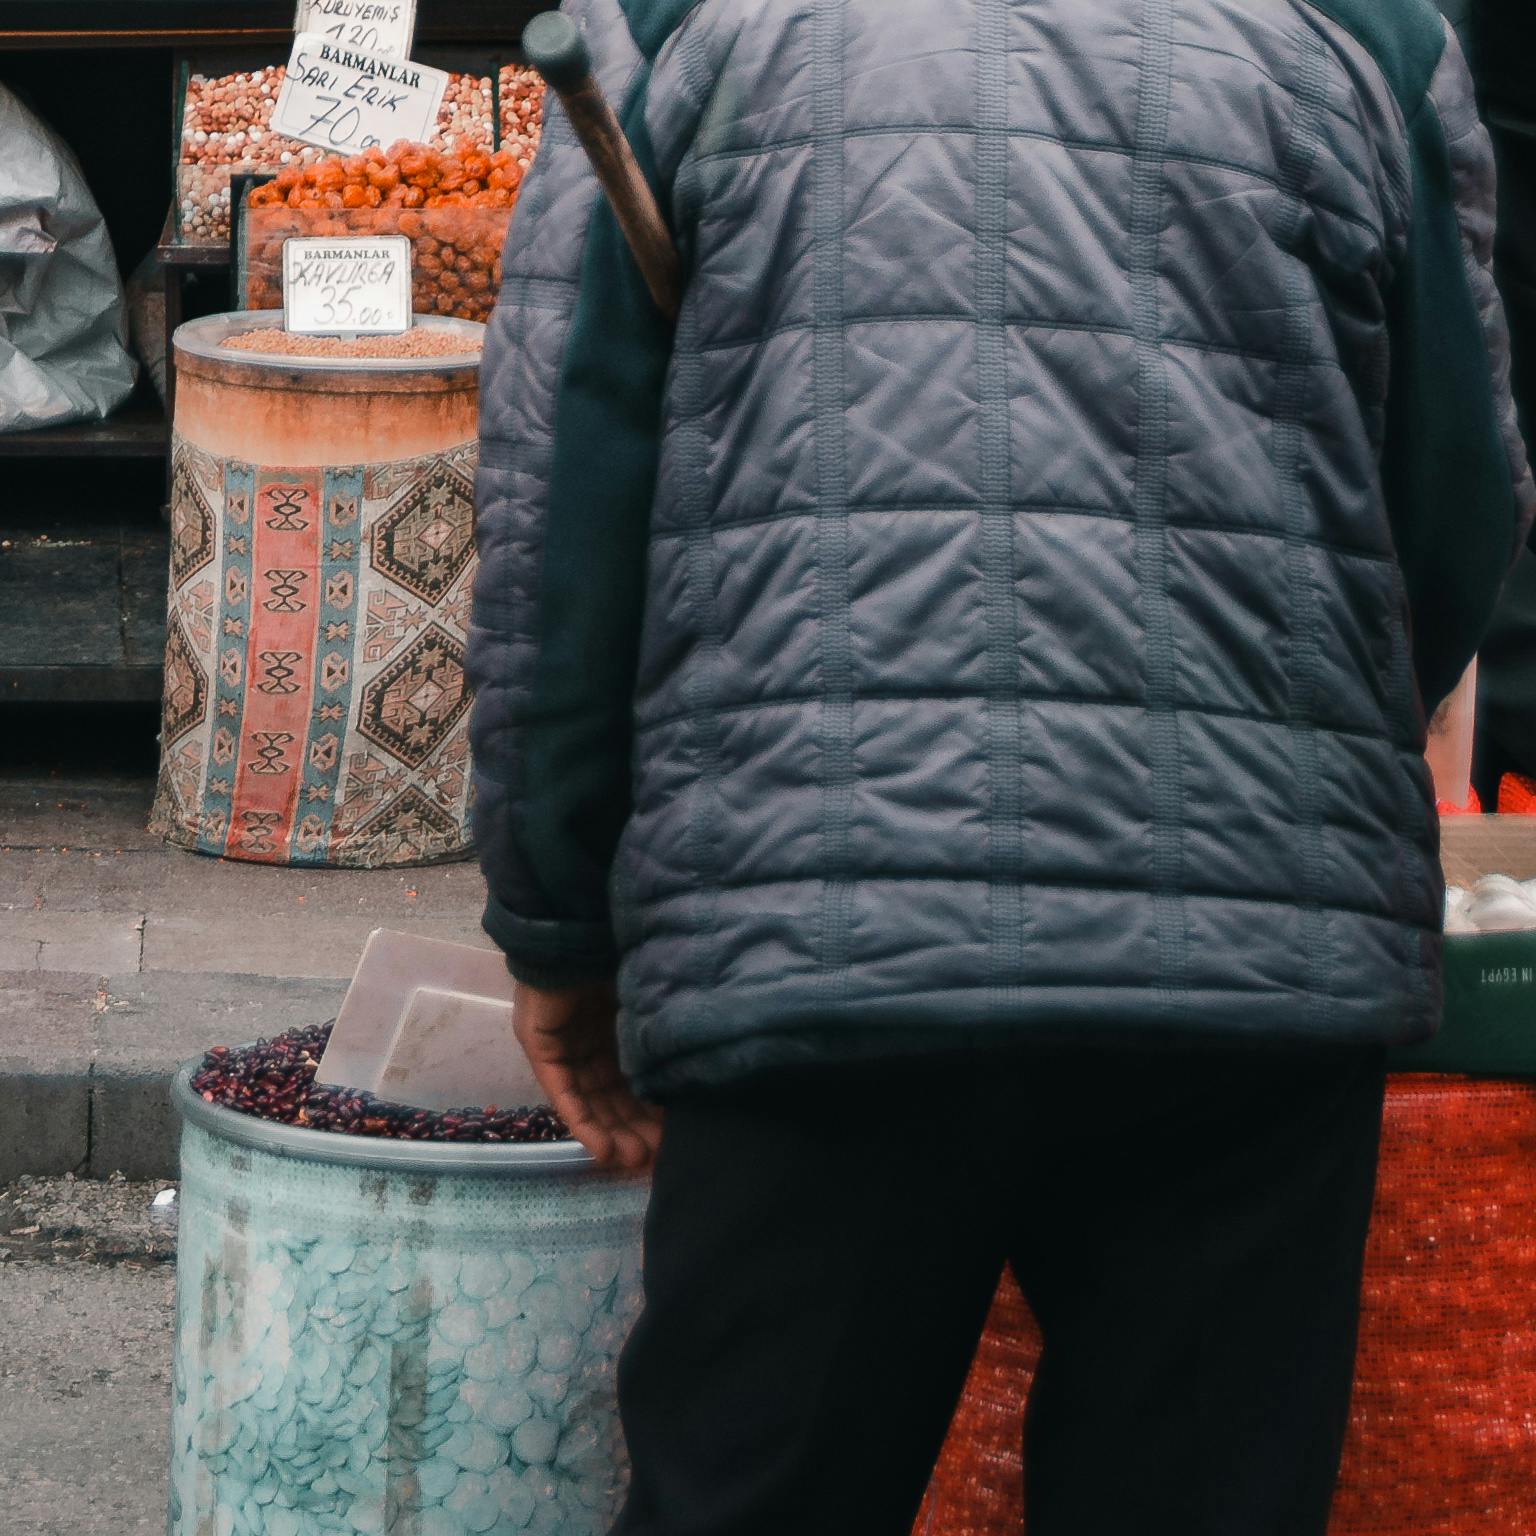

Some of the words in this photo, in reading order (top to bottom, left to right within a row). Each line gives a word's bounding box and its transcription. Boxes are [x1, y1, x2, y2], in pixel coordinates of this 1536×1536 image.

[285, 52, 339, 91] SARI
[319, 44, 421, 89] BARMANLAR
[304, 249, 391, 260] BARMANLAR
